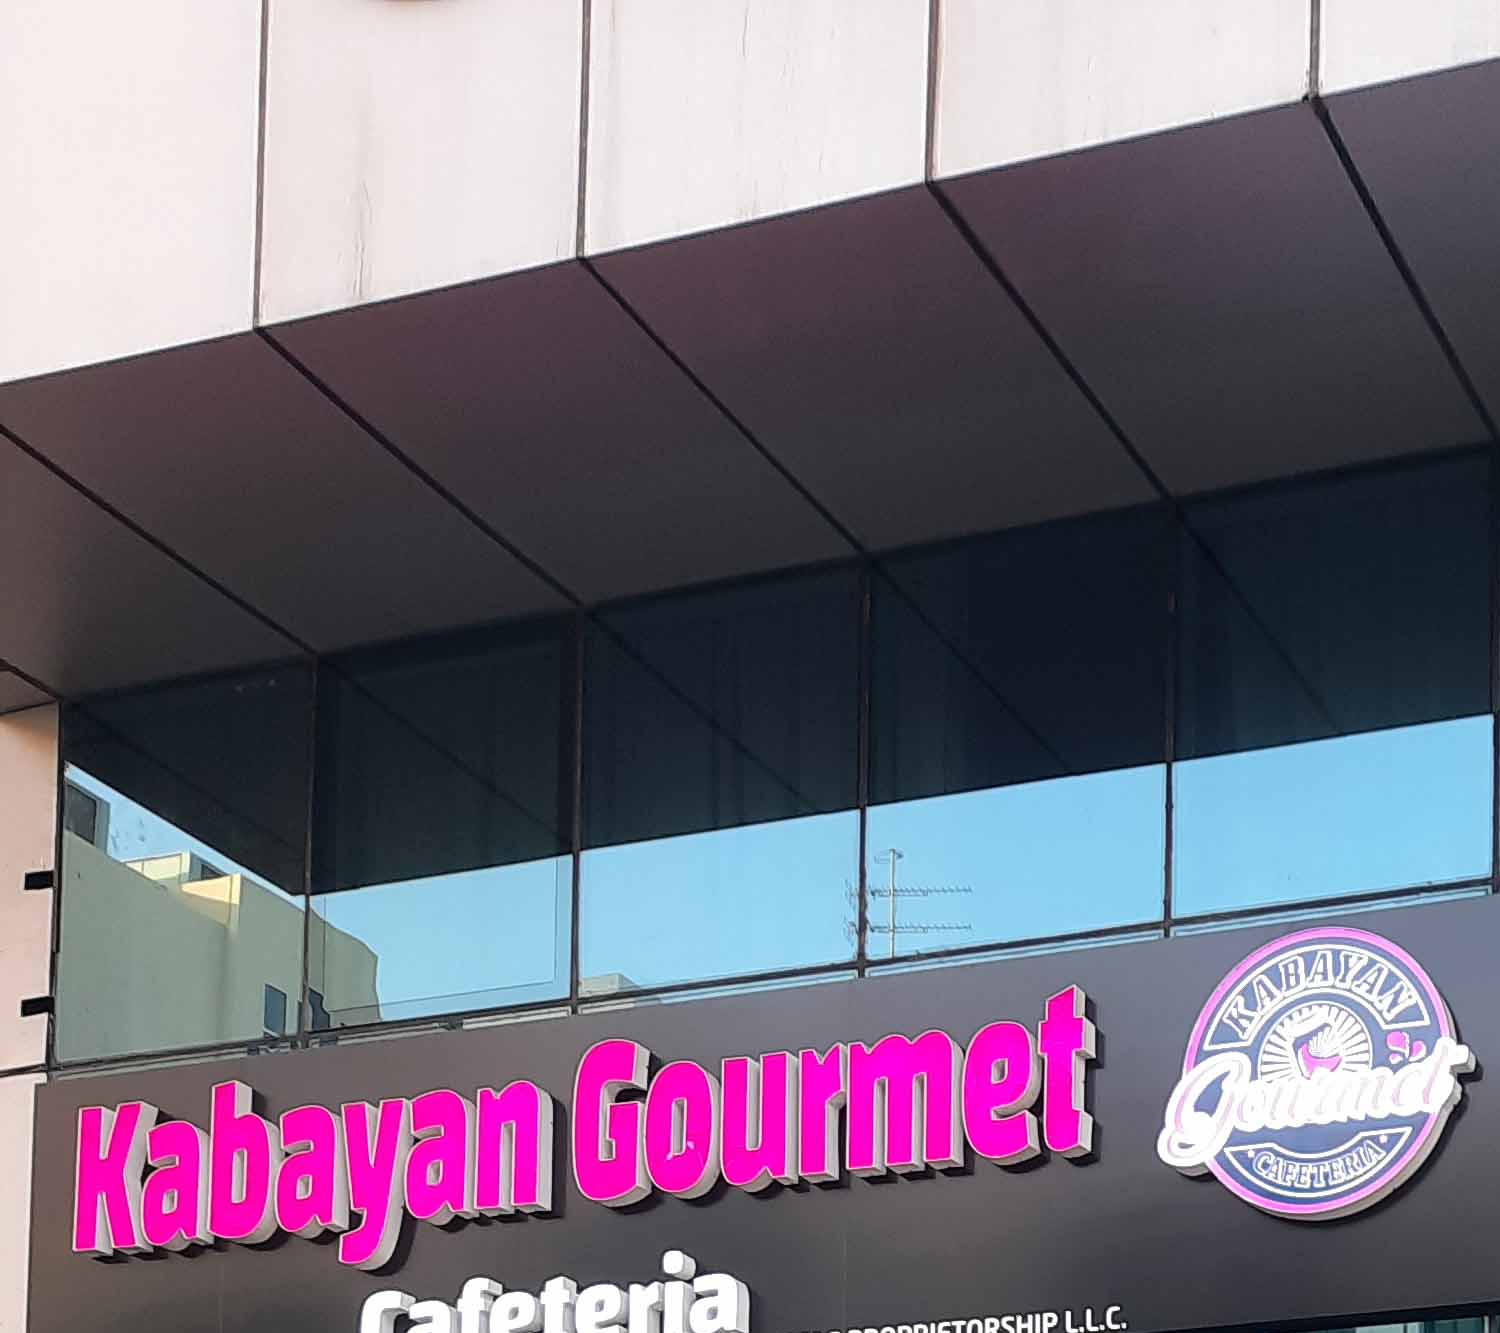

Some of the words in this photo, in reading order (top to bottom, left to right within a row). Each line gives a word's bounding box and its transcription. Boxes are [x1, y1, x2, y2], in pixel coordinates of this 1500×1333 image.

[1222, 950, 1419, 1040] KABAYAN
[74, 1080, 556, 1269] Kabayan
[573, 983, 1096, 1207] Gourmet
[1251, 1139, 1388, 1190] CAFETERIA
[1065, 1305, 1127, 1333] L.L.C.
